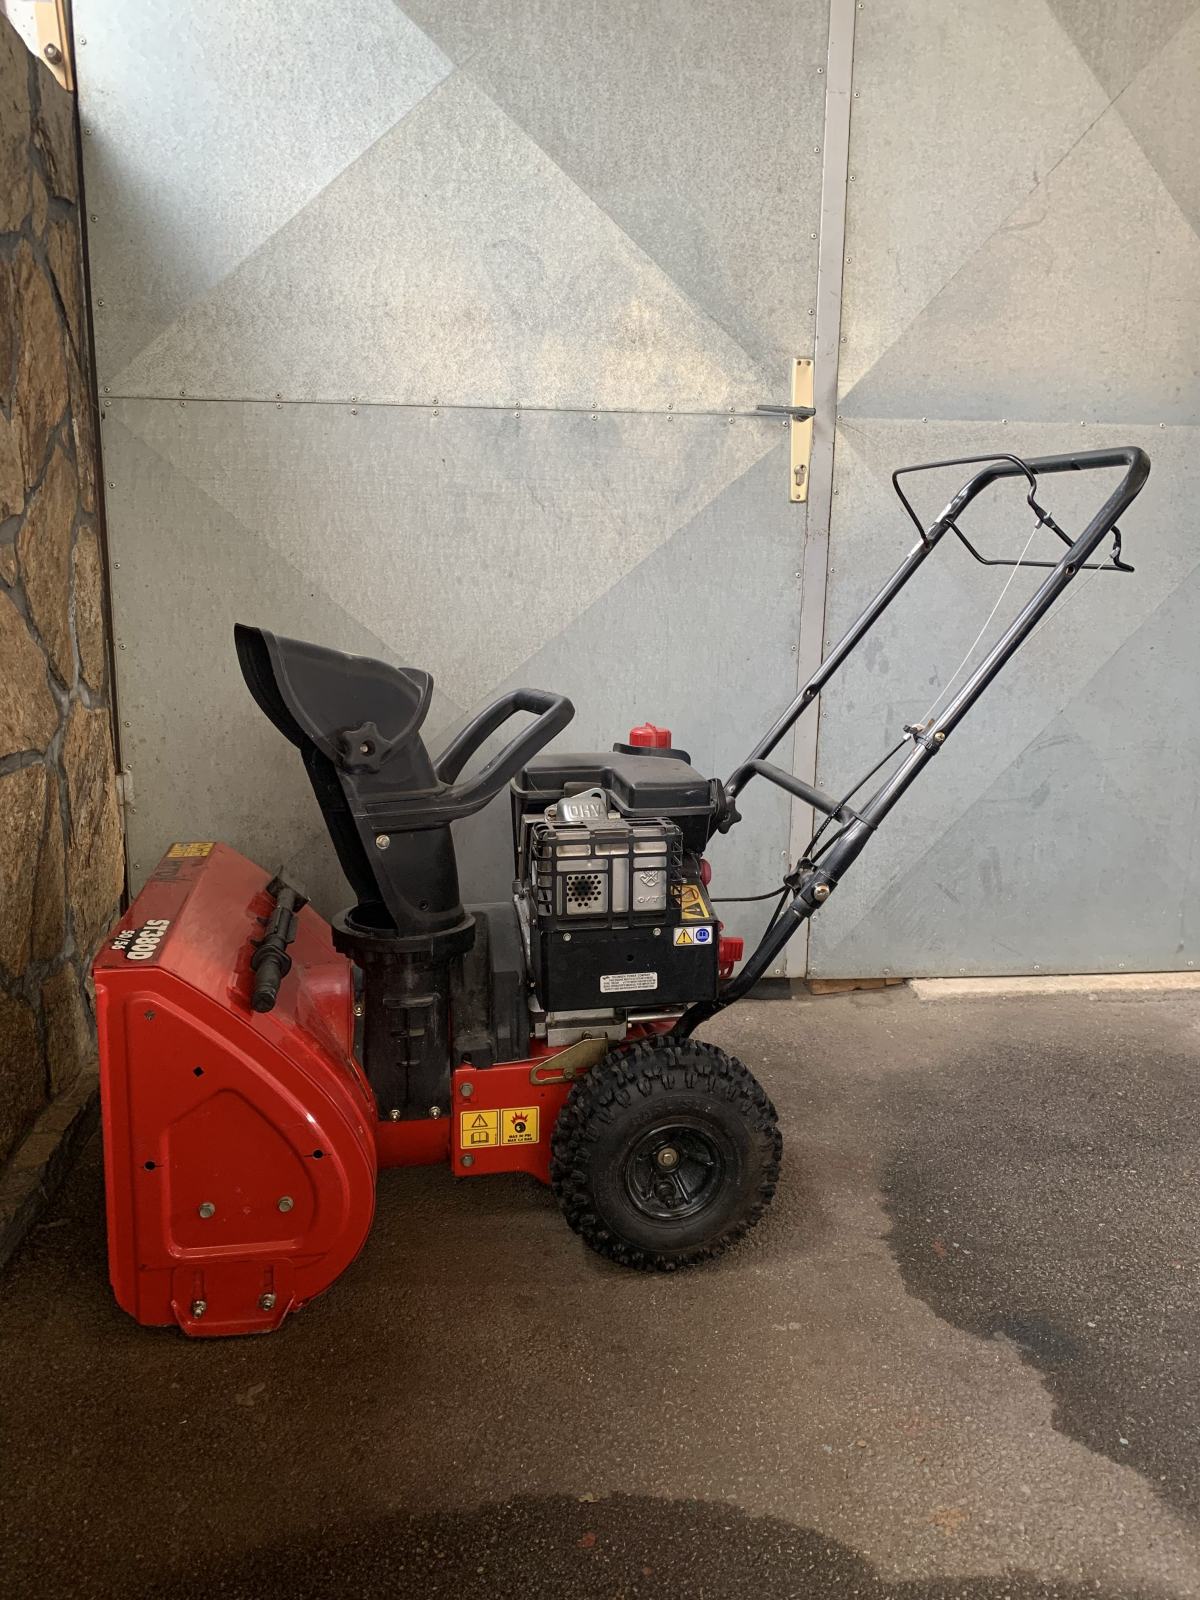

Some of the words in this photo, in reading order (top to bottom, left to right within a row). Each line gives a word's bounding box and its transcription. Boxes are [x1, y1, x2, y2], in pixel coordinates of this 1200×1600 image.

[568, 804, 601, 819] OHV
[111, 930, 136, 950] 50/56
[126, 919, 170, 960] ST380D
